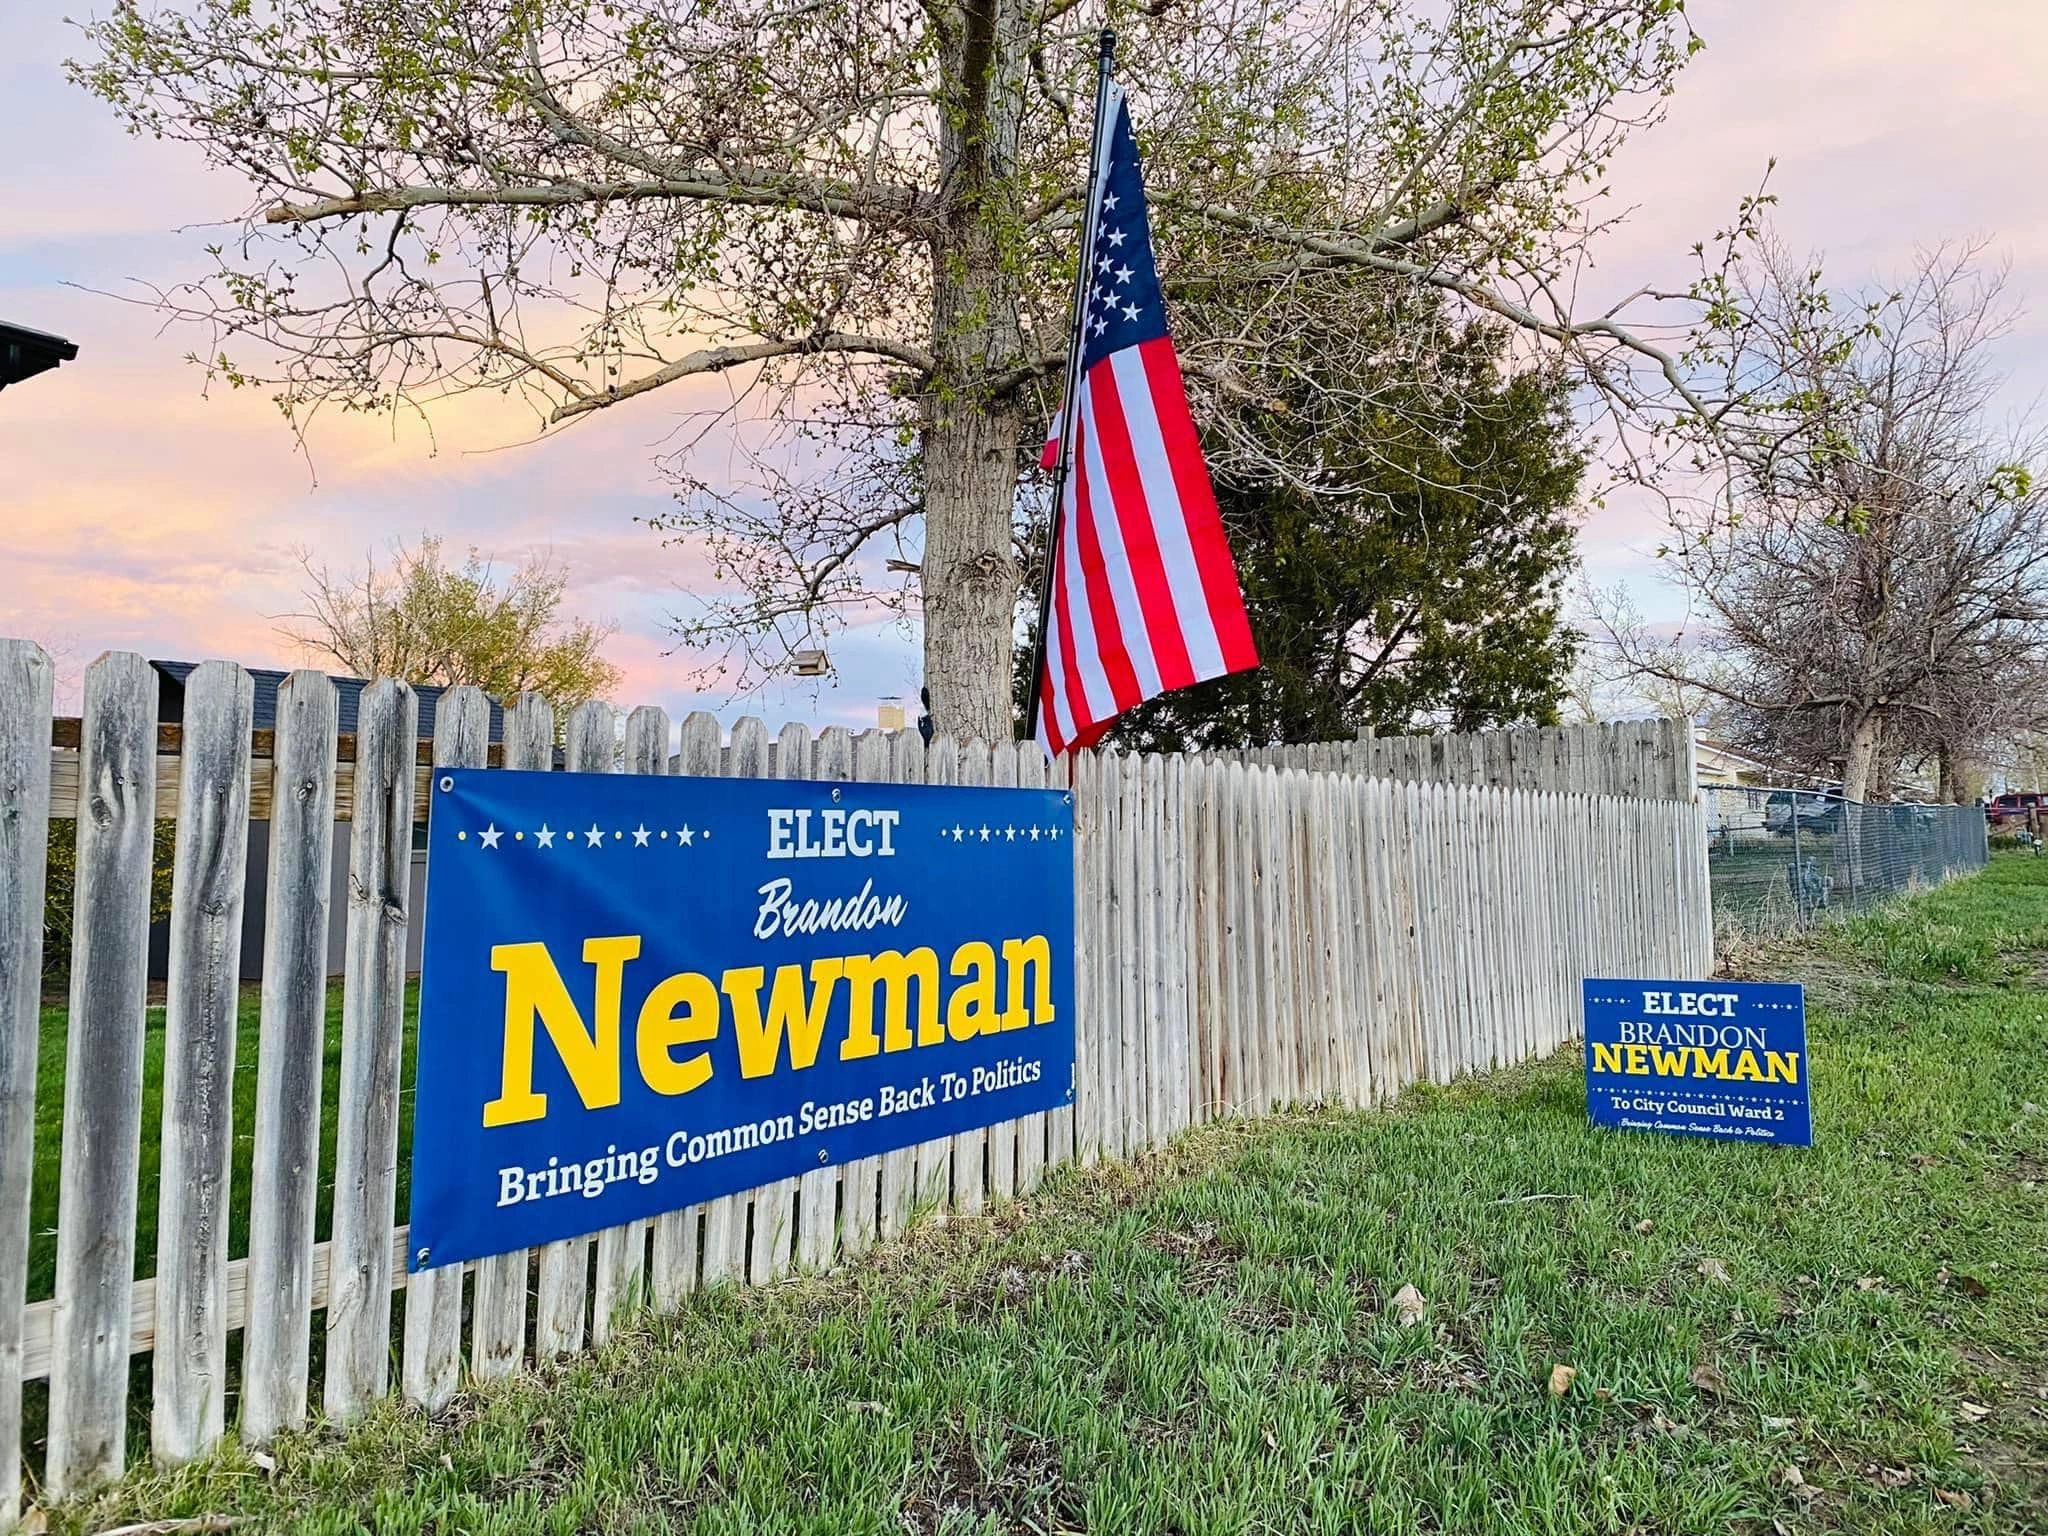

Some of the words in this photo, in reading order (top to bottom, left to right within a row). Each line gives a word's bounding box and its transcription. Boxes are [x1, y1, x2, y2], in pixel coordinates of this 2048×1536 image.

[767, 809, 899, 859] ELECT
[753, 877, 909, 940] Brandon
[1643, 991, 1739, 1017] ELECT
[482, 934, 1054, 1127] Newman
[1619, 1021, 1767, 1050] BRANDON
[1592, 1043, 1799, 1084] NEWMAN
[1611, 1096, 1630, 1110] To
[1633, 1098, 1664, 1115] City
[1667, 1101, 1725, 1116] Council
[1728, 1104, 1773, 1120] Ward
[1775, 1109, 1785, 1121] 2
[496, 1145, 660, 1207] Bringing
[666, 1115, 794, 1168] Common
[799, 1100, 874, 1135] Sense
[878, 1077, 936, 1118] Back
[940, 1072, 968, 1103] To
[971, 1056, 1042, 1096] Politics
